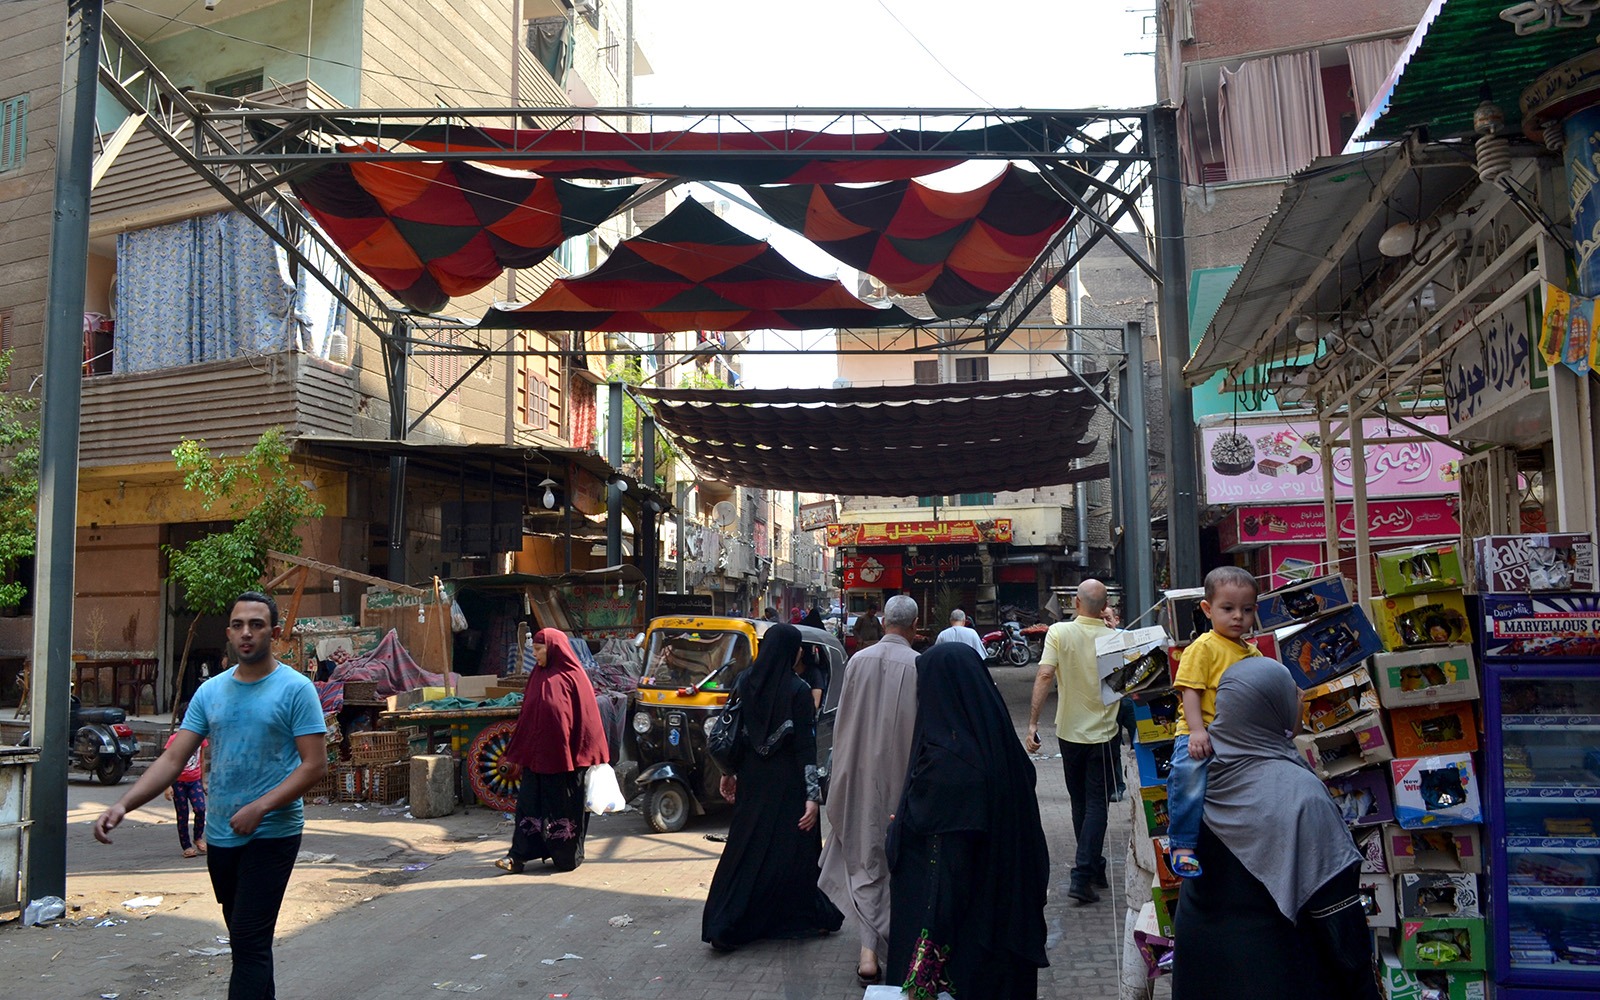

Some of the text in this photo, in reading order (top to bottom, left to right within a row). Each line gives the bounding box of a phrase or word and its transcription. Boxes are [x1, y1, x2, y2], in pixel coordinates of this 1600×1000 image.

[1210, 479, 1243, 500] ميلاد
[1494, 602, 1530, 618] Dairy Milk
[1504, 619, 1588, 634] MARVELLOUS
